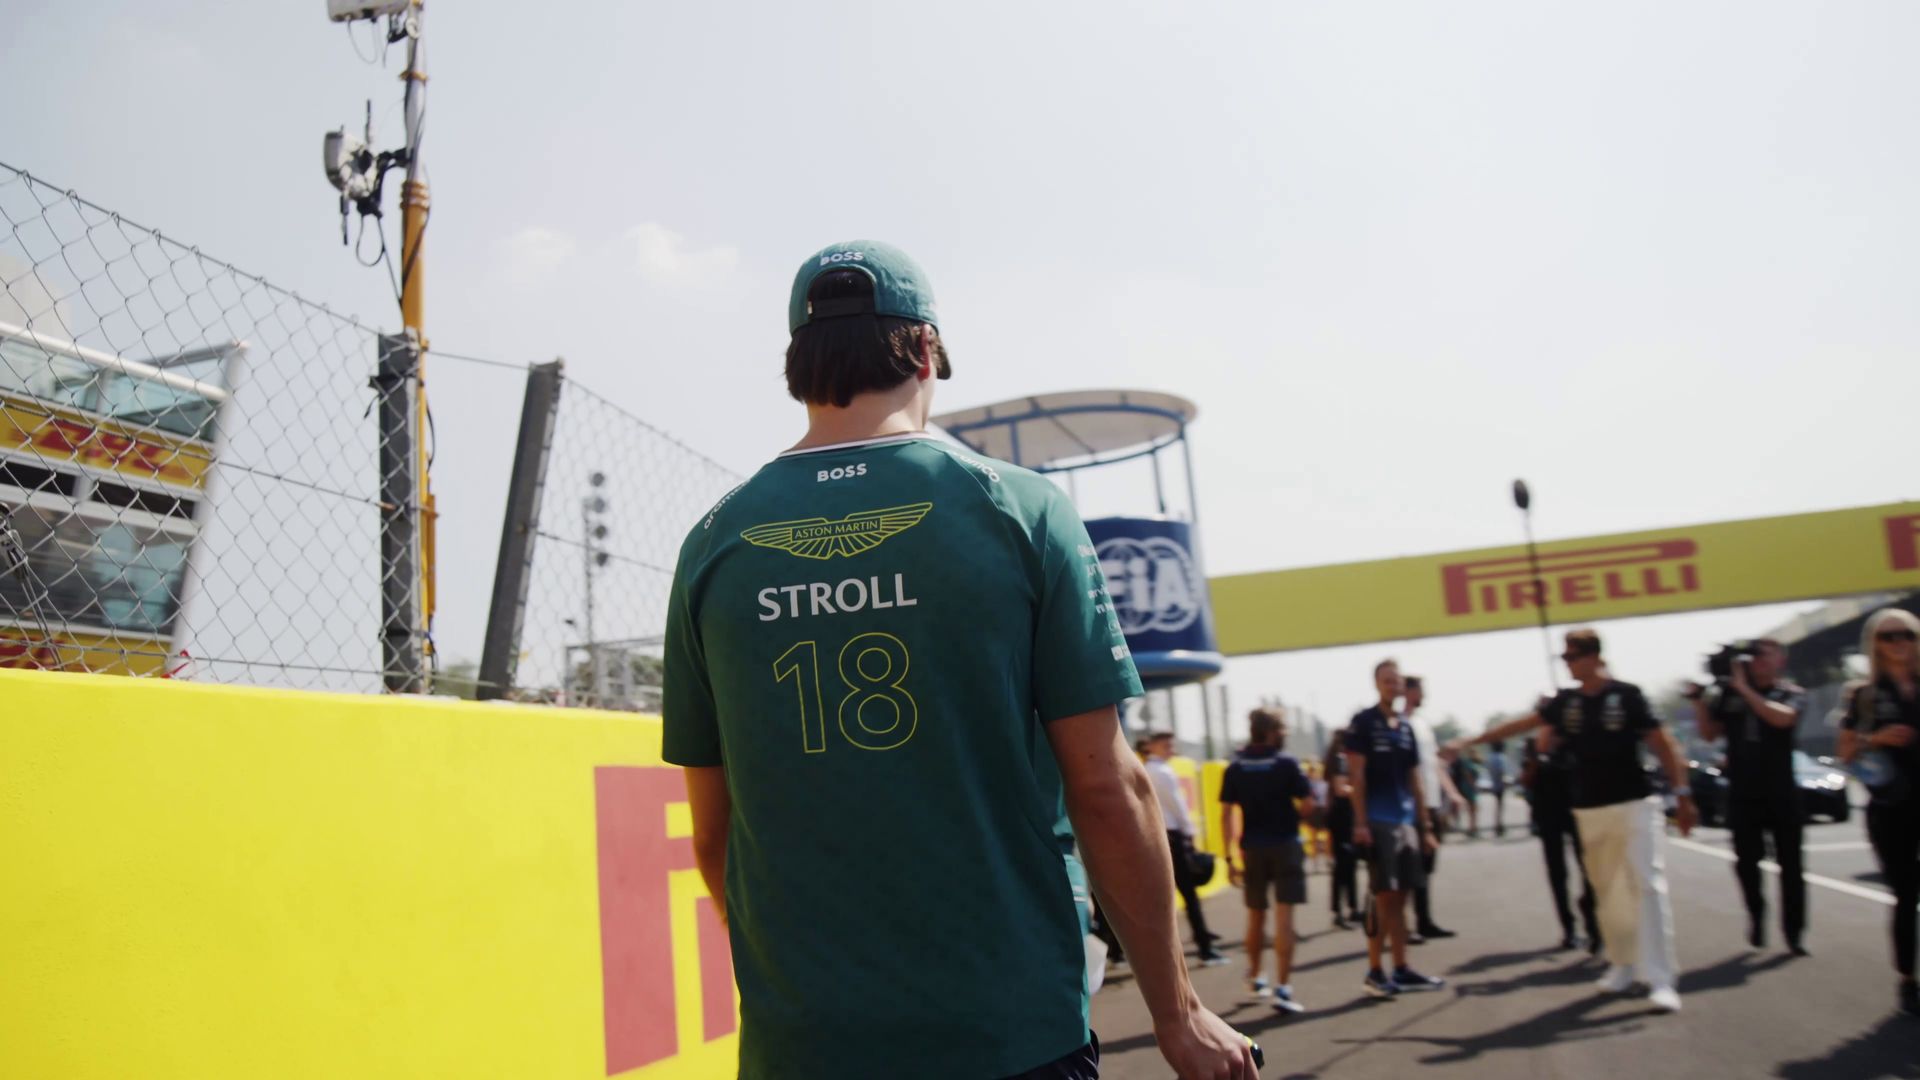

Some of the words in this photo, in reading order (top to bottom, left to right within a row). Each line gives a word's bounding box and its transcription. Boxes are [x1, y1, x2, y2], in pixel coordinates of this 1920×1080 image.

[820, 251, 864, 266] BOSS
[816, 463, 868, 482] BOSS
[794, 526, 832, 540] ASTON
[835, 520, 879, 534] MARTIN
[1441, 538, 1701, 616] PIRELLI
[757, 573, 918, 622] STROLL
[773, 632, 918, 754] 18
